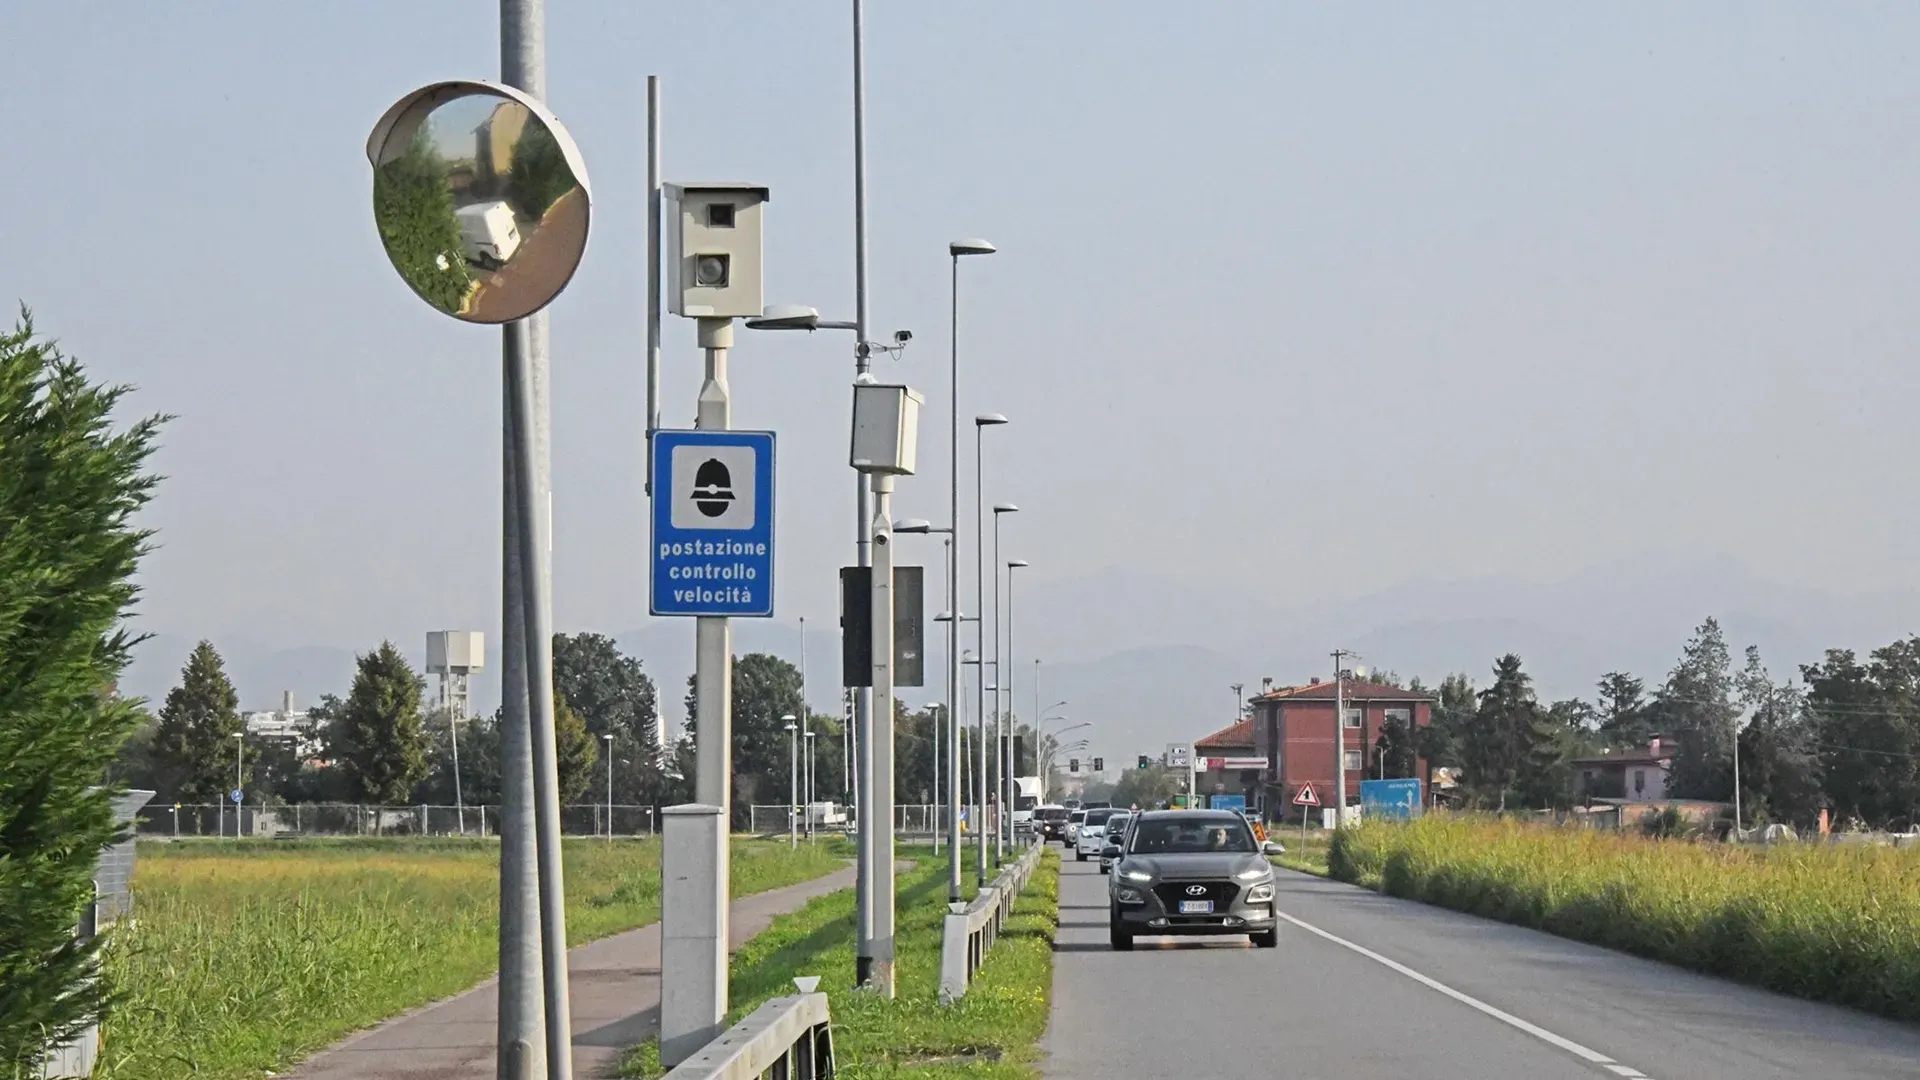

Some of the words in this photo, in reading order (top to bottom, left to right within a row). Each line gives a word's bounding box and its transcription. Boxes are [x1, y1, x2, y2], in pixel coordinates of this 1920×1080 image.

[660, 539, 766, 560] postazione
[669, 563, 756, 579] controllo
[674, 586, 751, 603] velocità
